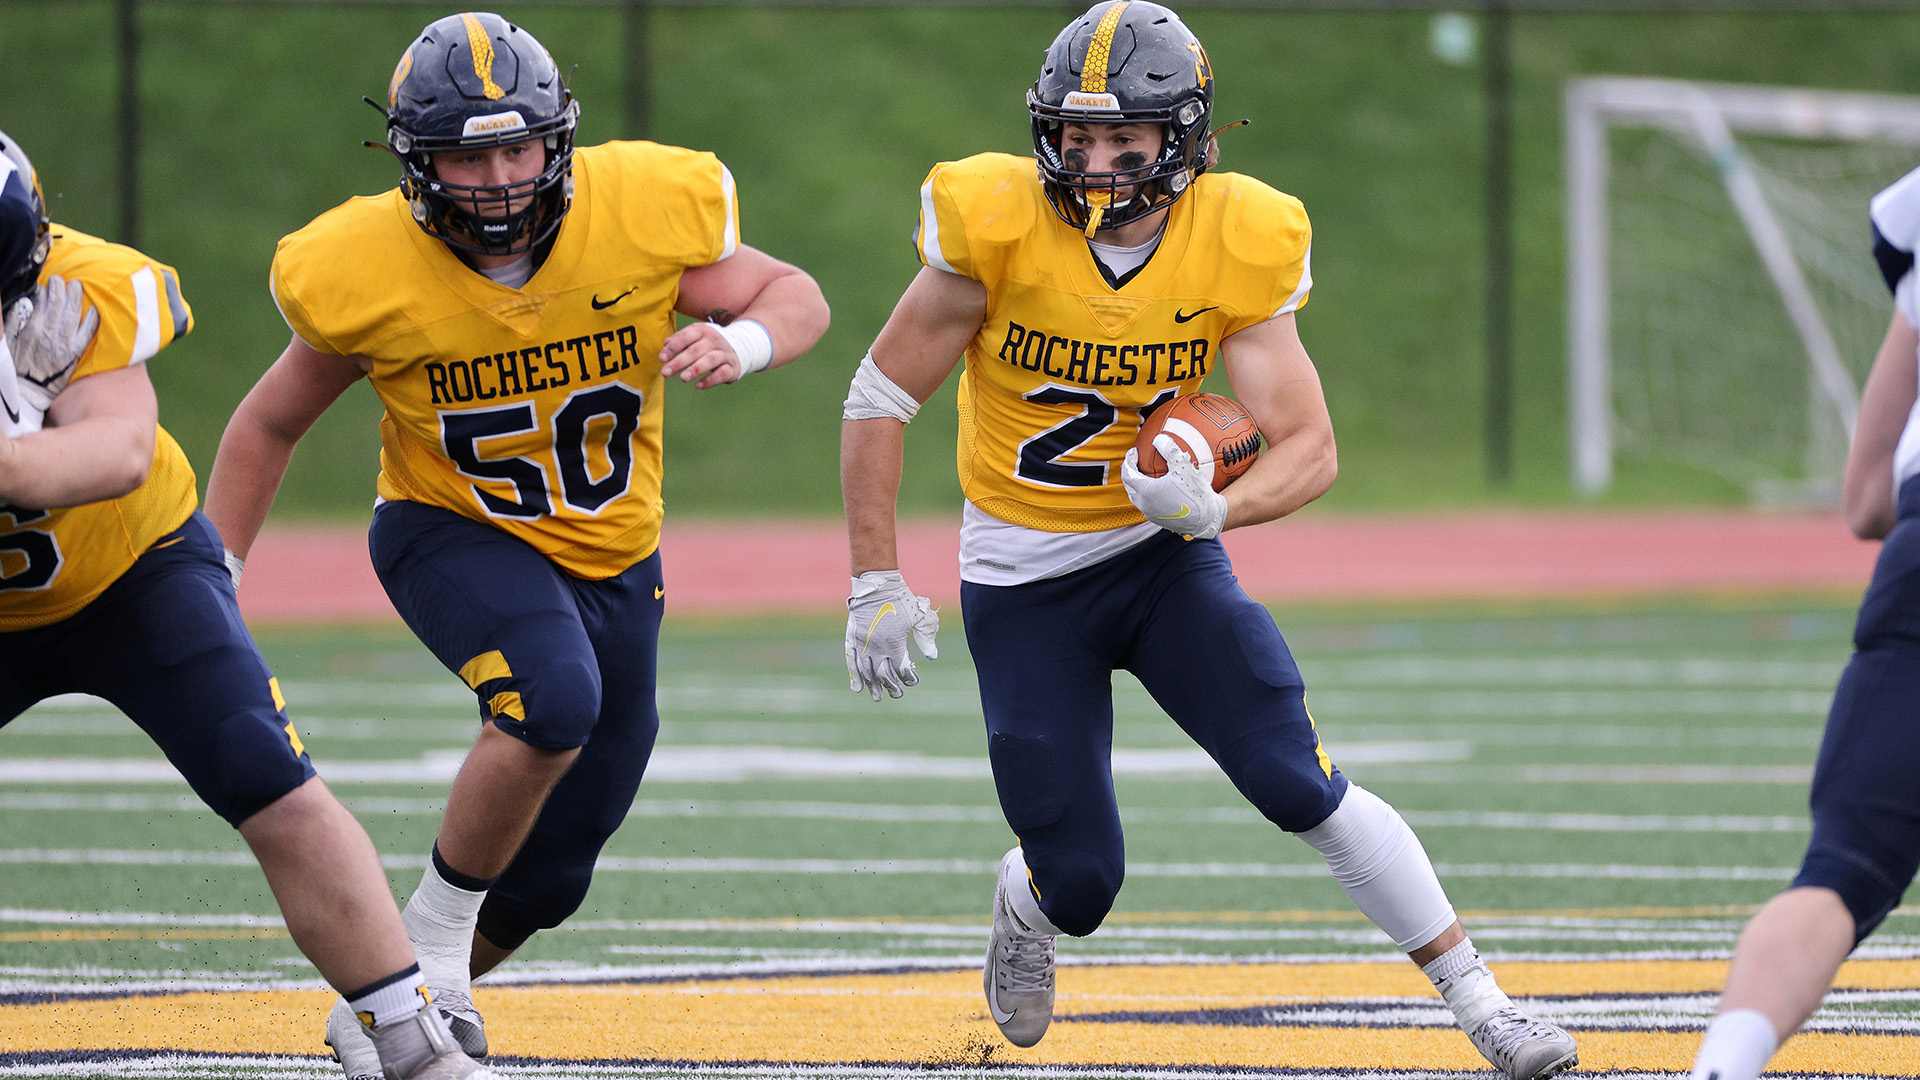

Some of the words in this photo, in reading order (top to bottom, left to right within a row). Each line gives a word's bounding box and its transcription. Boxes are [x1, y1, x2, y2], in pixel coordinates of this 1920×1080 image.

[1040, 135, 1064, 170] Riddell
[483, 224, 508, 232] Riddell
[425, 325, 641, 404] ROCHESTER
[998, 320, 1209, 386] ROCHESTER
[437, 379, 644, 521] 50
